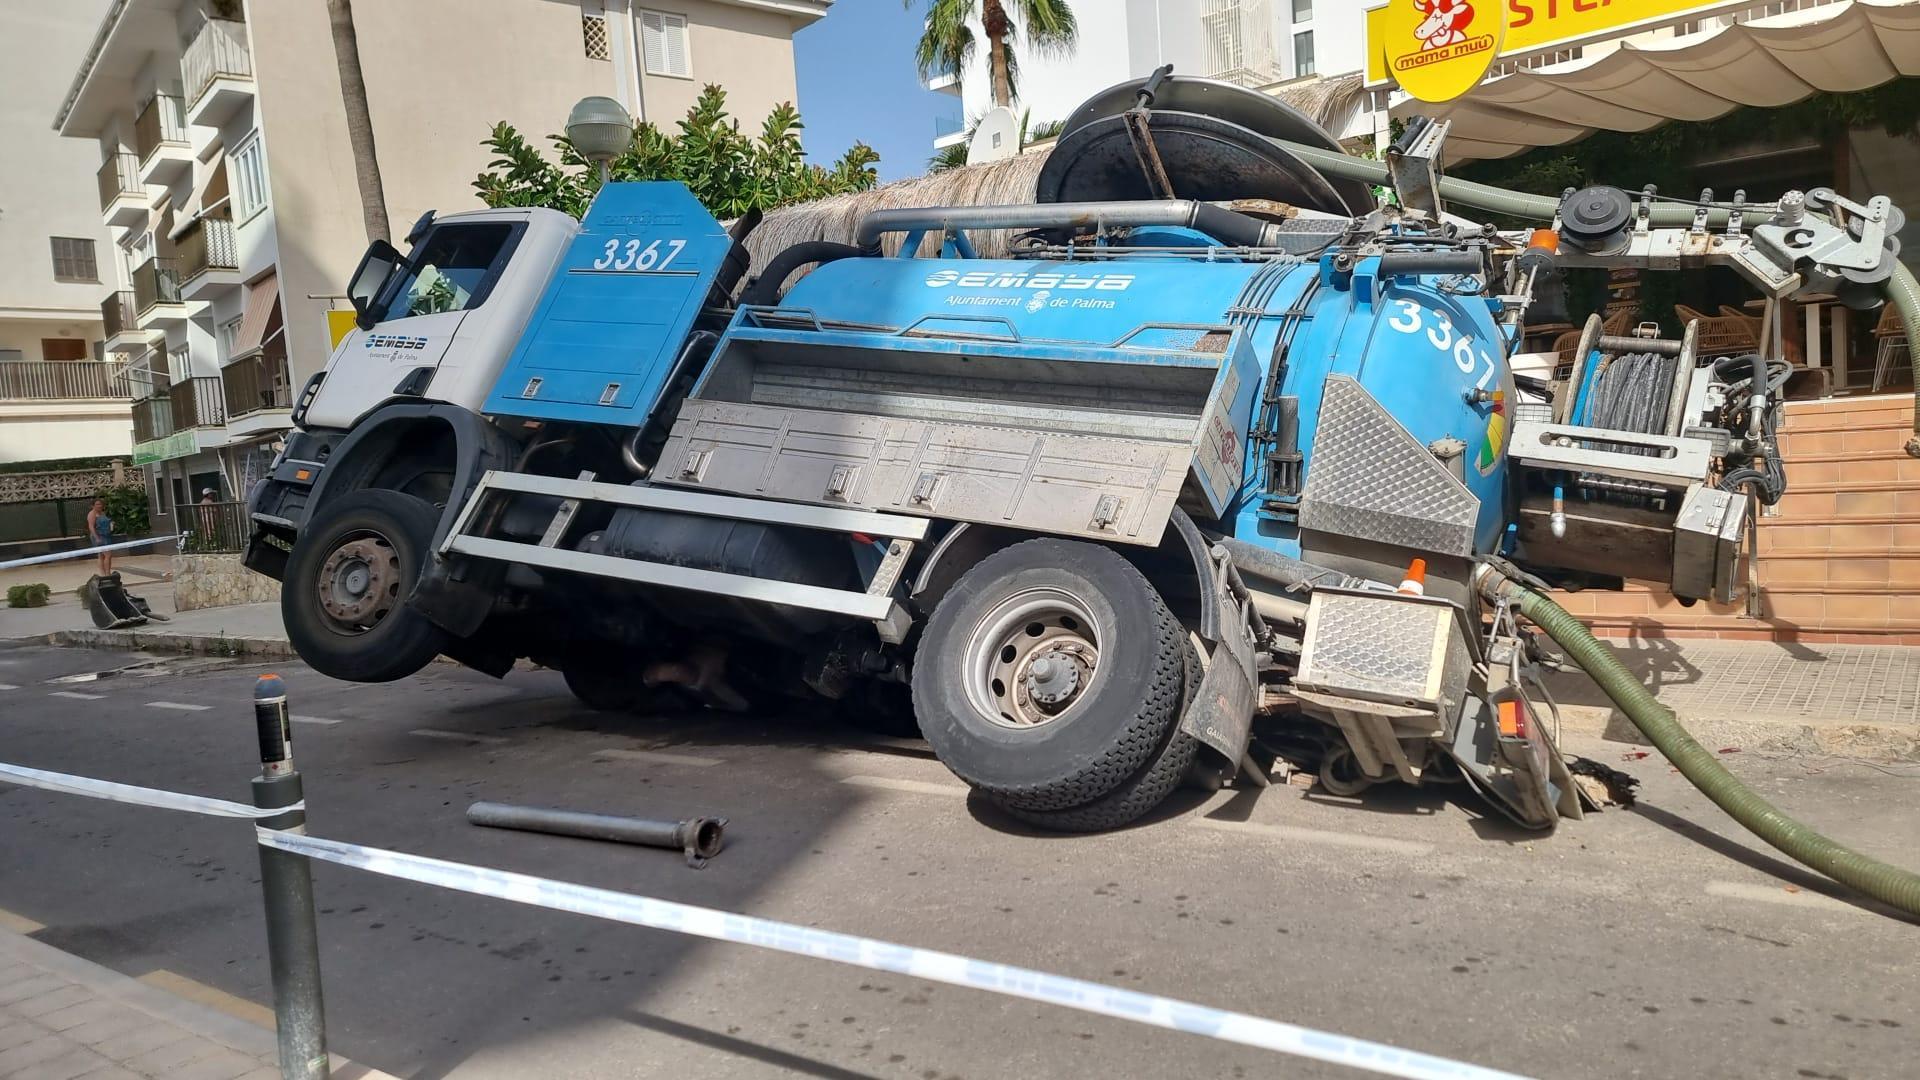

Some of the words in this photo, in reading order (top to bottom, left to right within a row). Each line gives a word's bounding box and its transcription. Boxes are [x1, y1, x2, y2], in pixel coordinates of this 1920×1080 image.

[1400, 49, 1450, 69] mama
[1454, 35, 1488, 55] muú
[593, 238, 688, 271] 3367
[943, 294, 1022, 307] Ajuntament
[1049, 297, 1069, 308] de
[1071, 298, 1116, 310] Palma
[1388, 299, 1496, 391] 3367
